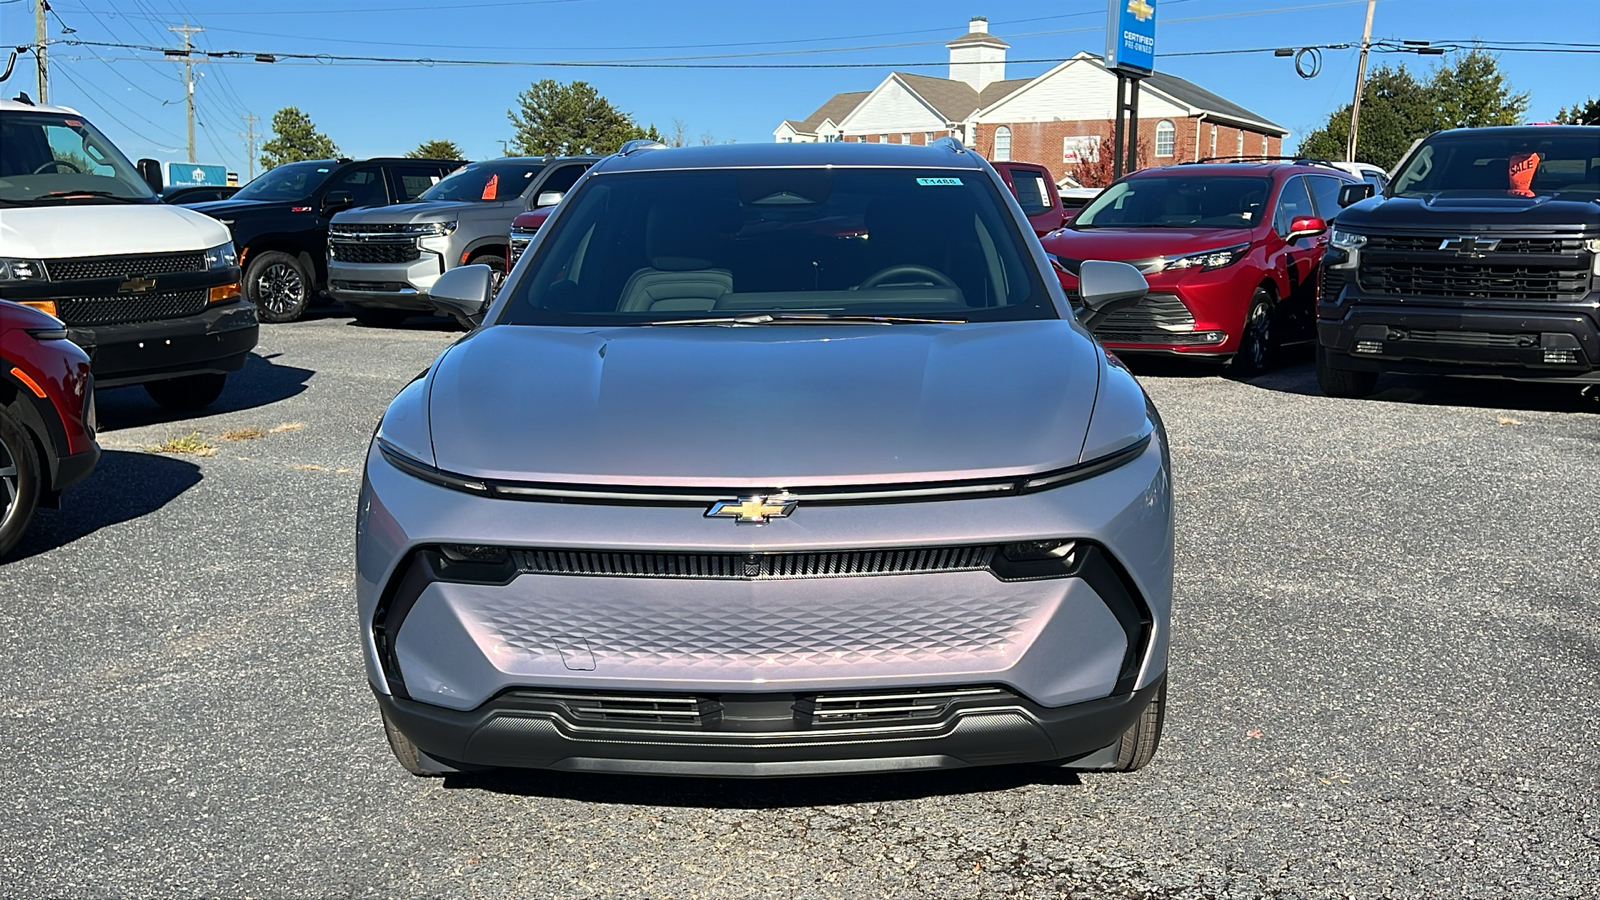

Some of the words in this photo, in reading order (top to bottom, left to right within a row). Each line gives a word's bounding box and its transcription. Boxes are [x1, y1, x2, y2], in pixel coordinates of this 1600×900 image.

[1124, 30, 1154, 46] CERTIFIED
[1125, 40, 1152, 54] PRE-OWNED
[1510, 160, 1533, 176] SALE
